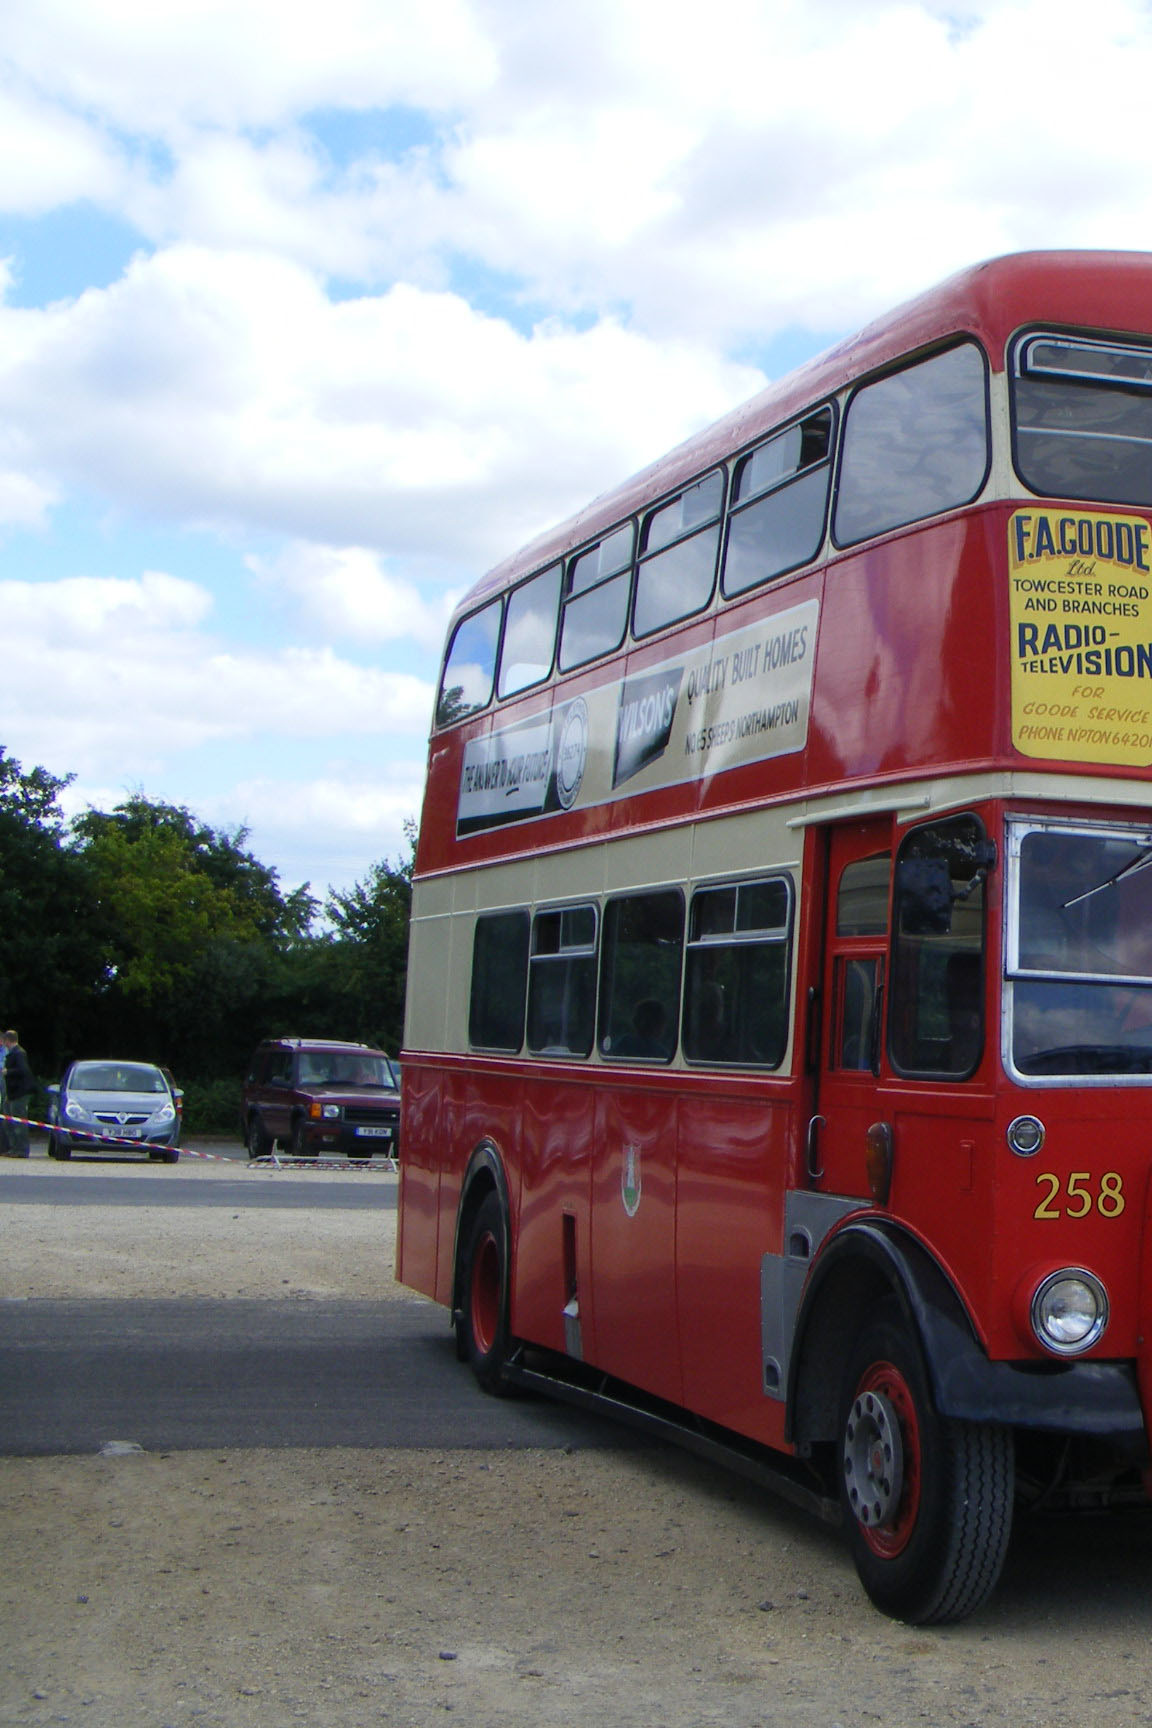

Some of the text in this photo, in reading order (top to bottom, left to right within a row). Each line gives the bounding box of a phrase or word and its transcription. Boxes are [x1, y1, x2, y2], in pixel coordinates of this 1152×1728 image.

[1013, 578, 1149, 600] TOWCESTER ROAD
[1024, 598, 1140, 617] AND BRANCHES
[687, 625, 808, 706] QUALITY BUILT HOMES
[1071, 686, 1106, 700] FOR
[736, 700, 798, 738] NORTHAMPTON
[1022, 702, 1151, 725] GOODE SERVICE
[1018, 724, 1065, 742] PHONE
[1033, 1171, 1127, 1220] 258
